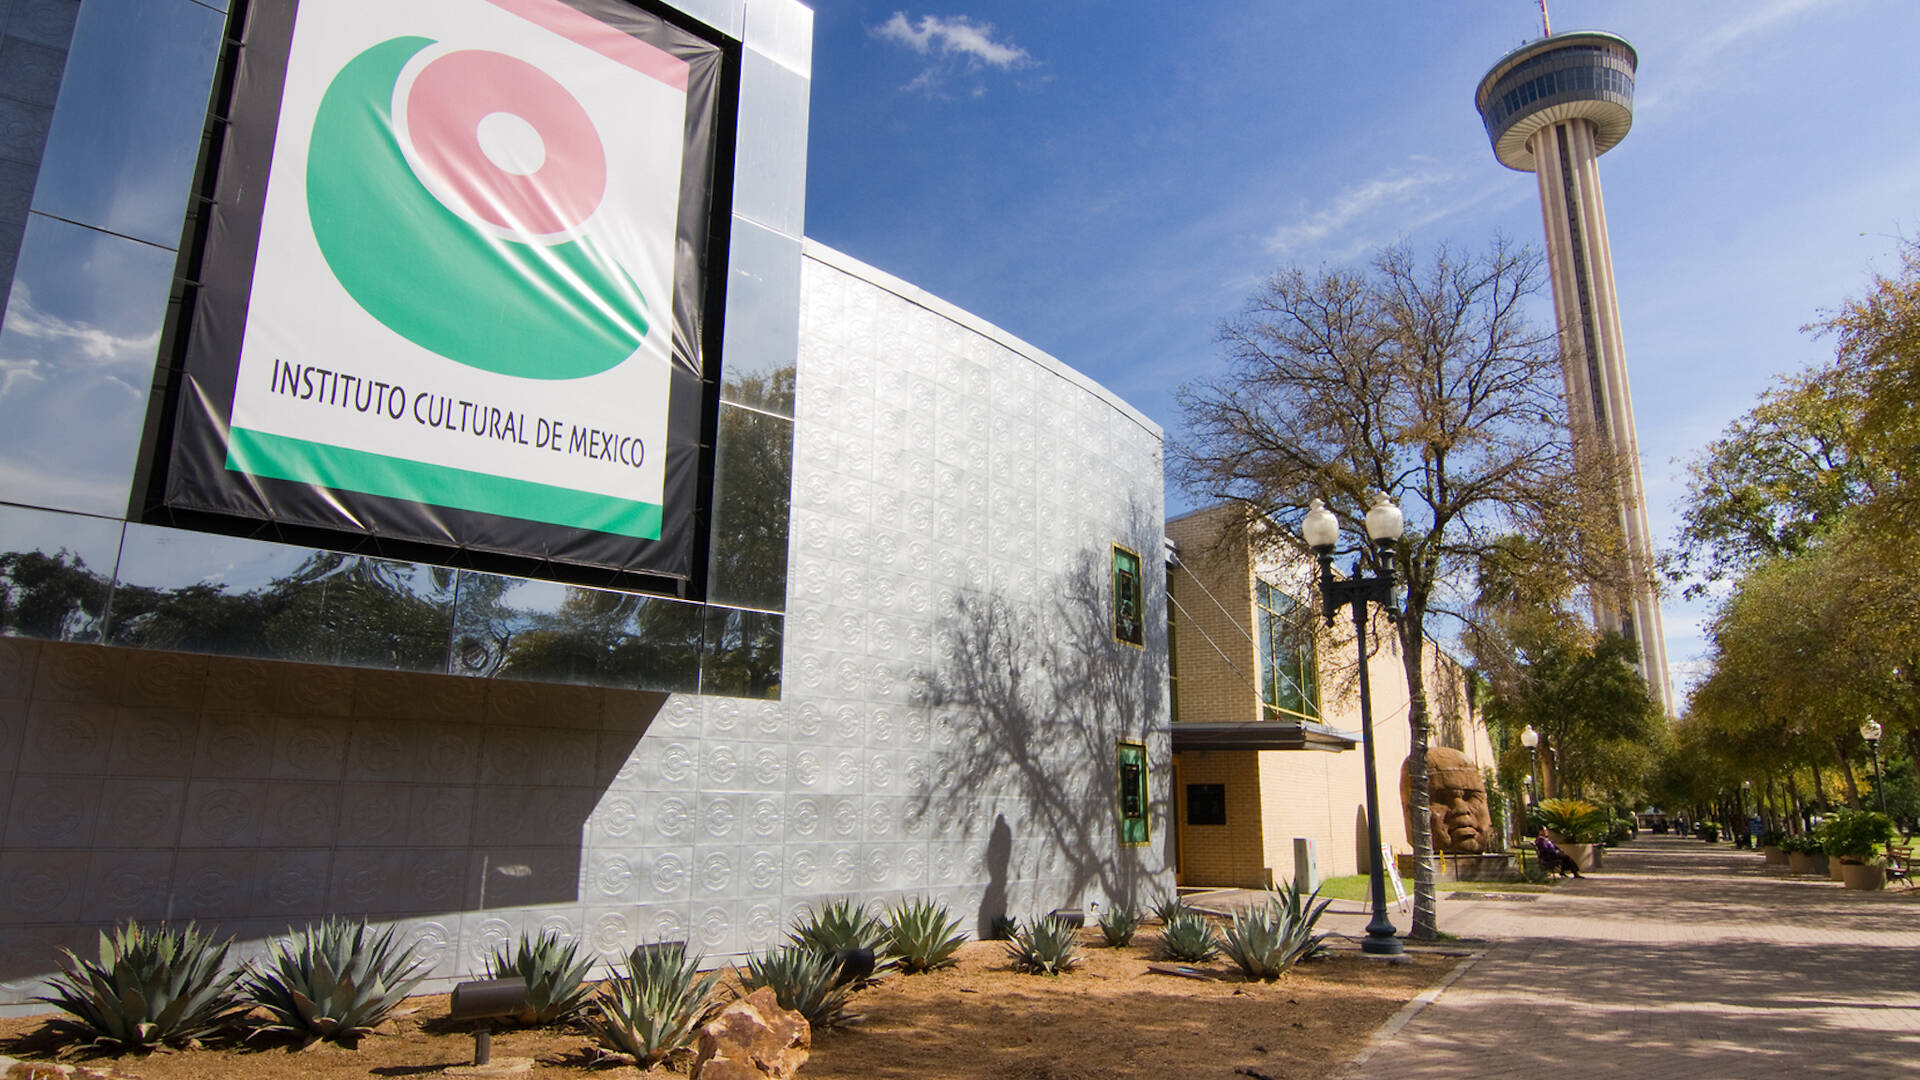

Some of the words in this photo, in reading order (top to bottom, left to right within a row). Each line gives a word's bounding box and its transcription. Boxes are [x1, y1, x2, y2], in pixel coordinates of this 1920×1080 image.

[271, 359, 406, 420] INSTITUTO
[413, 392, 529, 445] CULTURAL
[536, 417, 563, 452] DE
[568, 425, 645, 468] MEXICO
